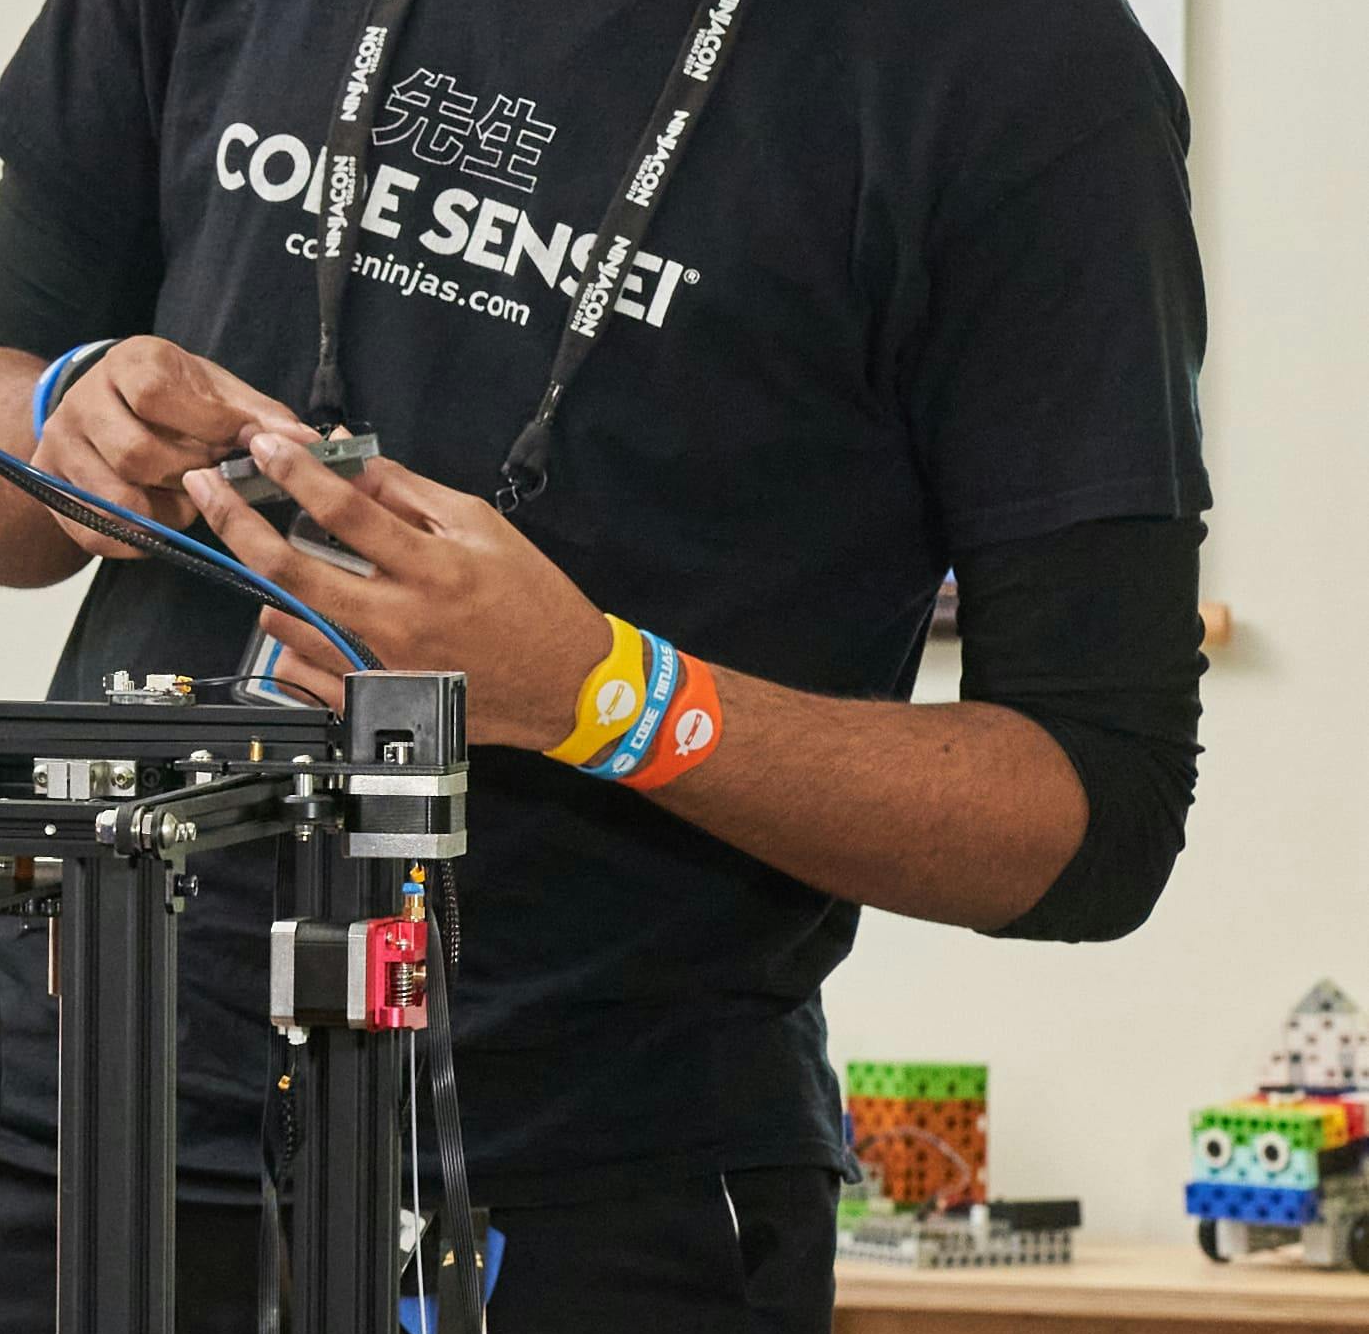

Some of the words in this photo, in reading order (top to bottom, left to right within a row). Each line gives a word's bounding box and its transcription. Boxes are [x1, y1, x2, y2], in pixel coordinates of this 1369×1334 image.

[340, 26, 381, 122] NINJACON
[371, 67, 557, 193] 先生
[633, 109, 691, 208] NINJACON
[324, 155, 349, 258] NINJACON
[577, 235, 632, 338] NINJACON
